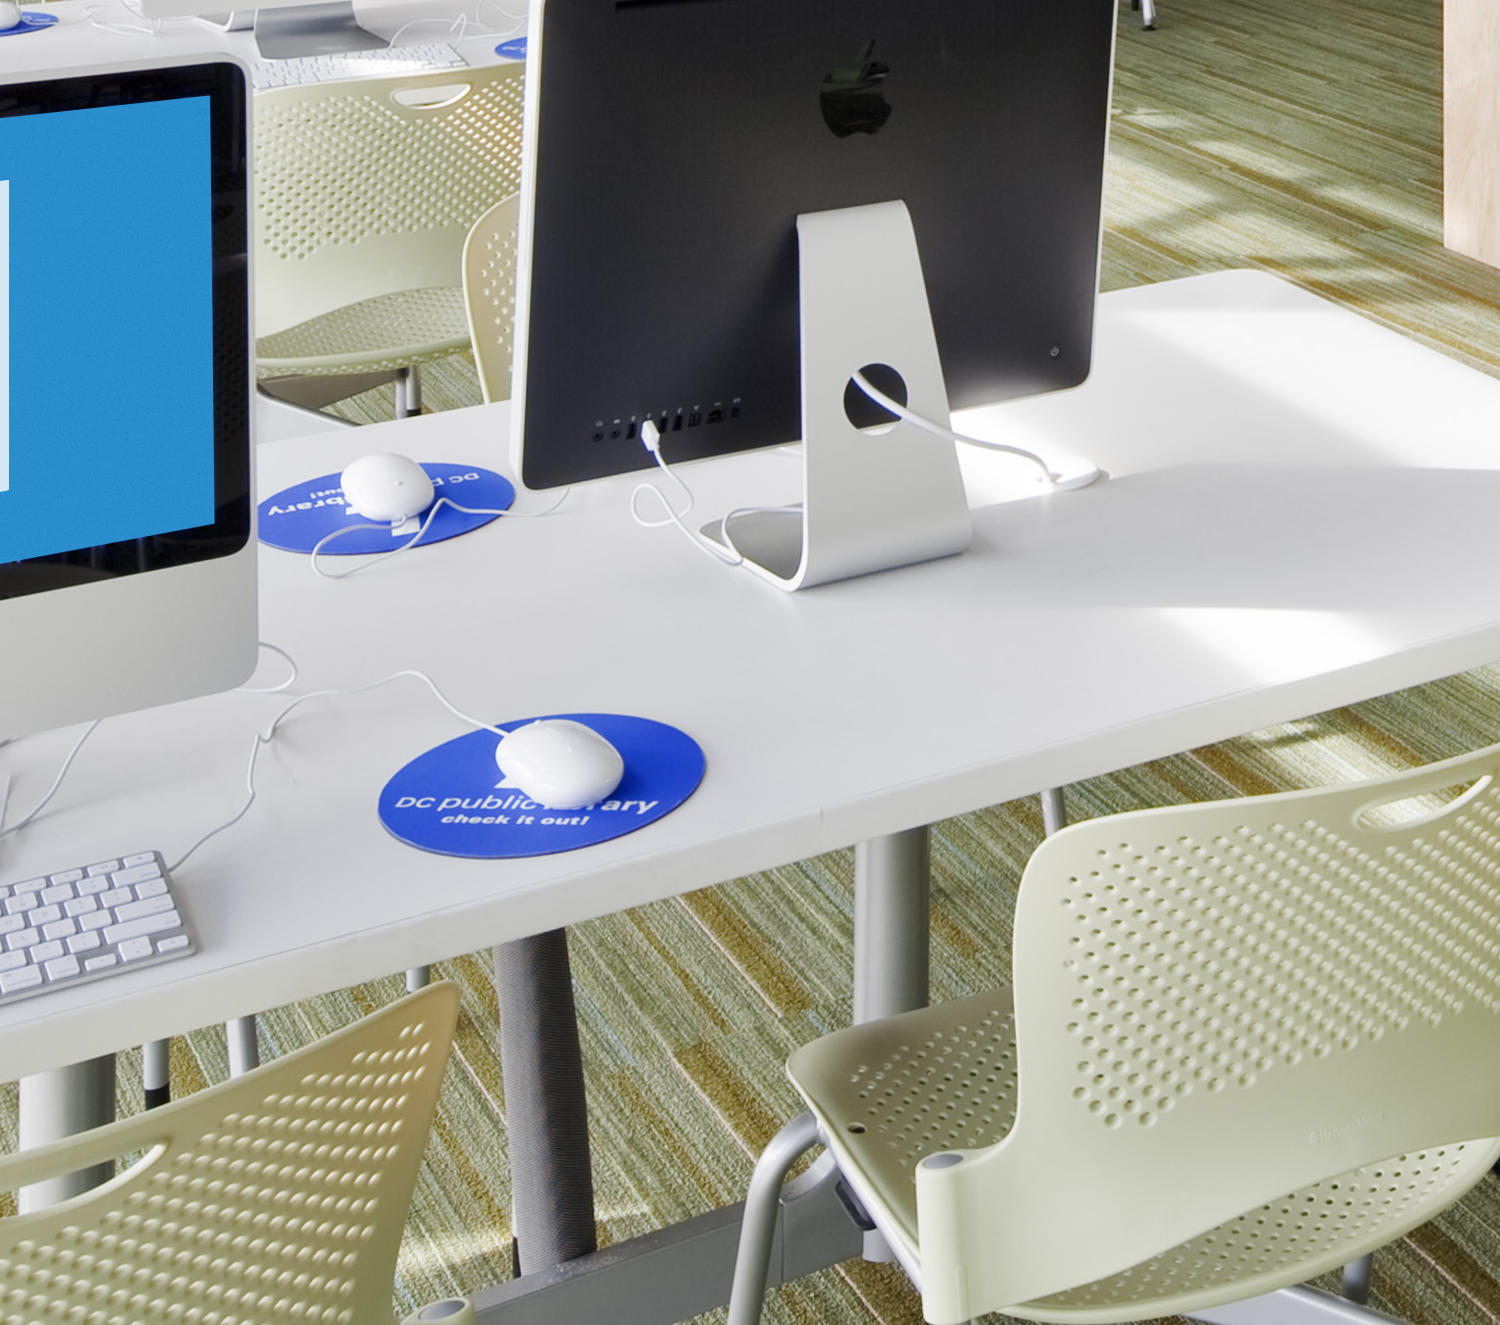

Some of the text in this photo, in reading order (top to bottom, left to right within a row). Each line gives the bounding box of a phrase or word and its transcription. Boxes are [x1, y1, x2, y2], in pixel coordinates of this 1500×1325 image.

[267, 497, 352, 517] brary
[395, 796, 436, 809] DC
[437, 795, 537, 813] public
[440, 814, 590, 826] check it out!
